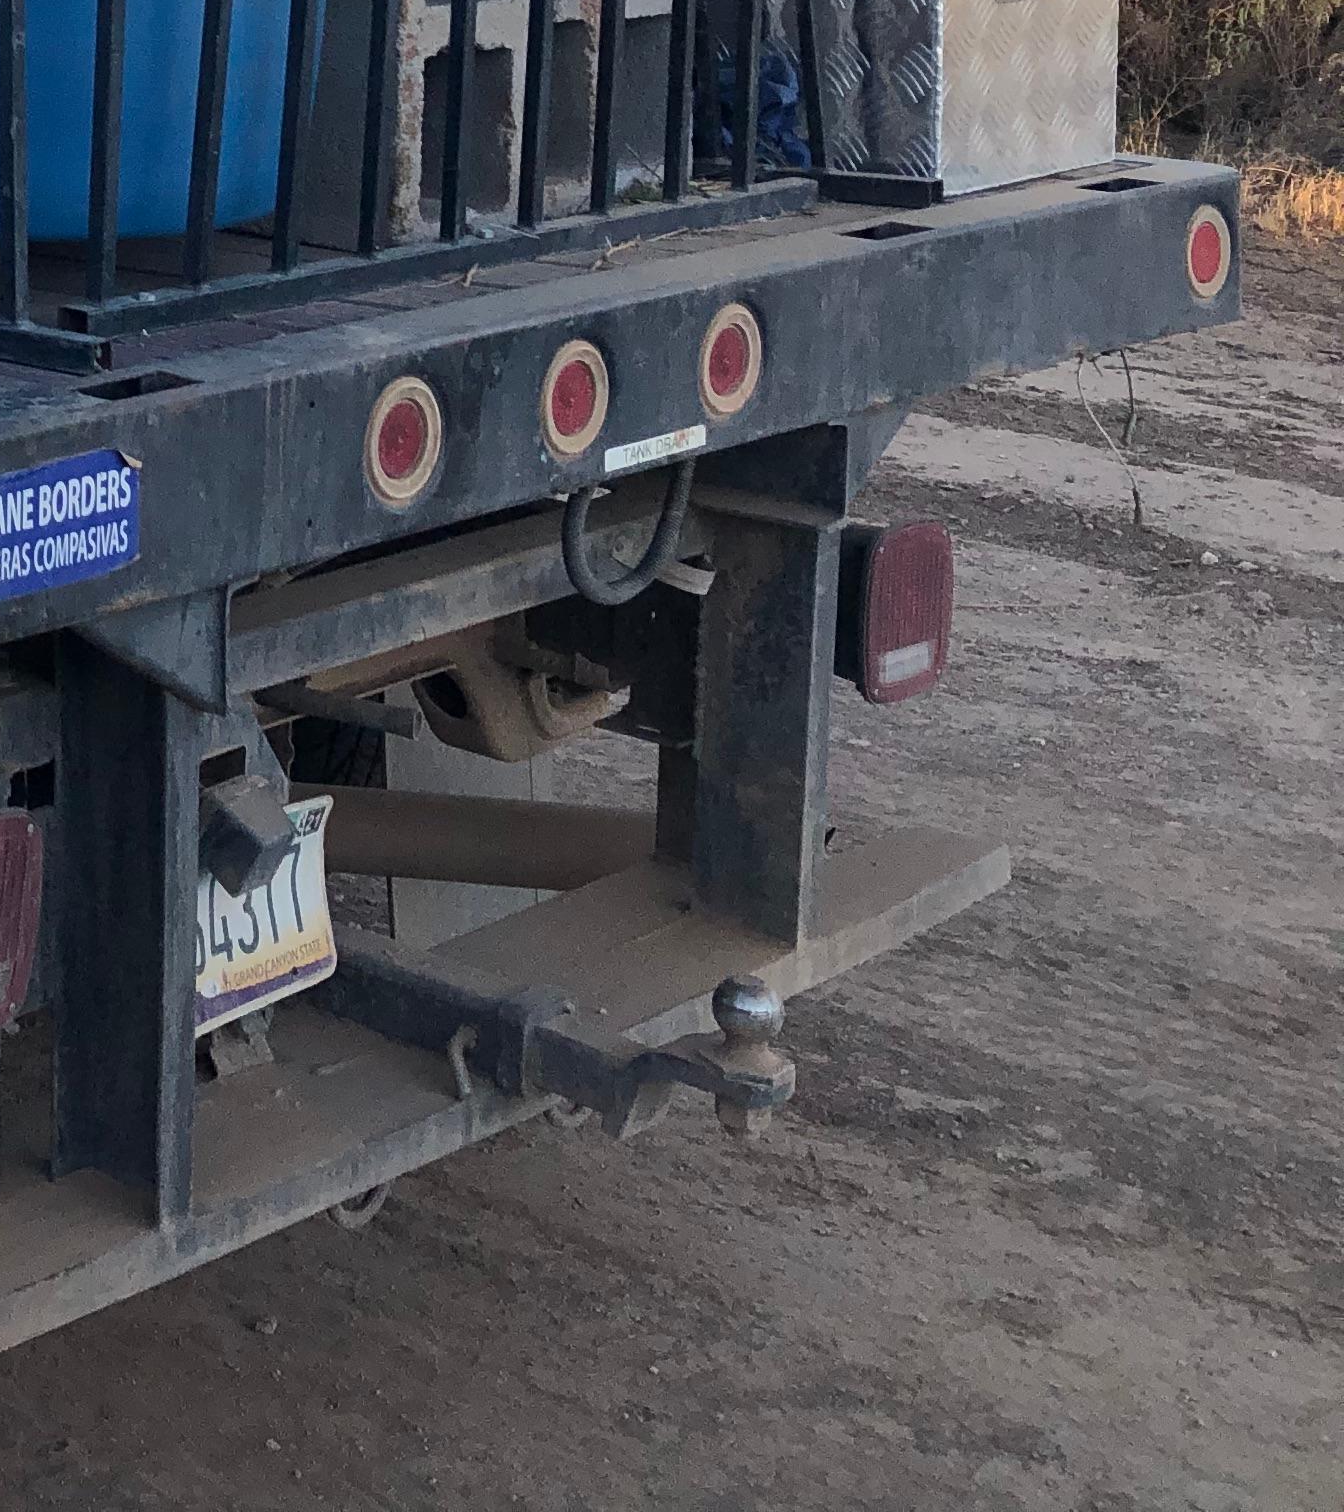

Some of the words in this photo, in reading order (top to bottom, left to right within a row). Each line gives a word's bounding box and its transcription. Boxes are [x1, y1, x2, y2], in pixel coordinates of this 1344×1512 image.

[623, 442, 652, 465] TANK
[38, 467, 131, 527] BORDERS
[33, 519, 128, 573] COMPASIVAS
